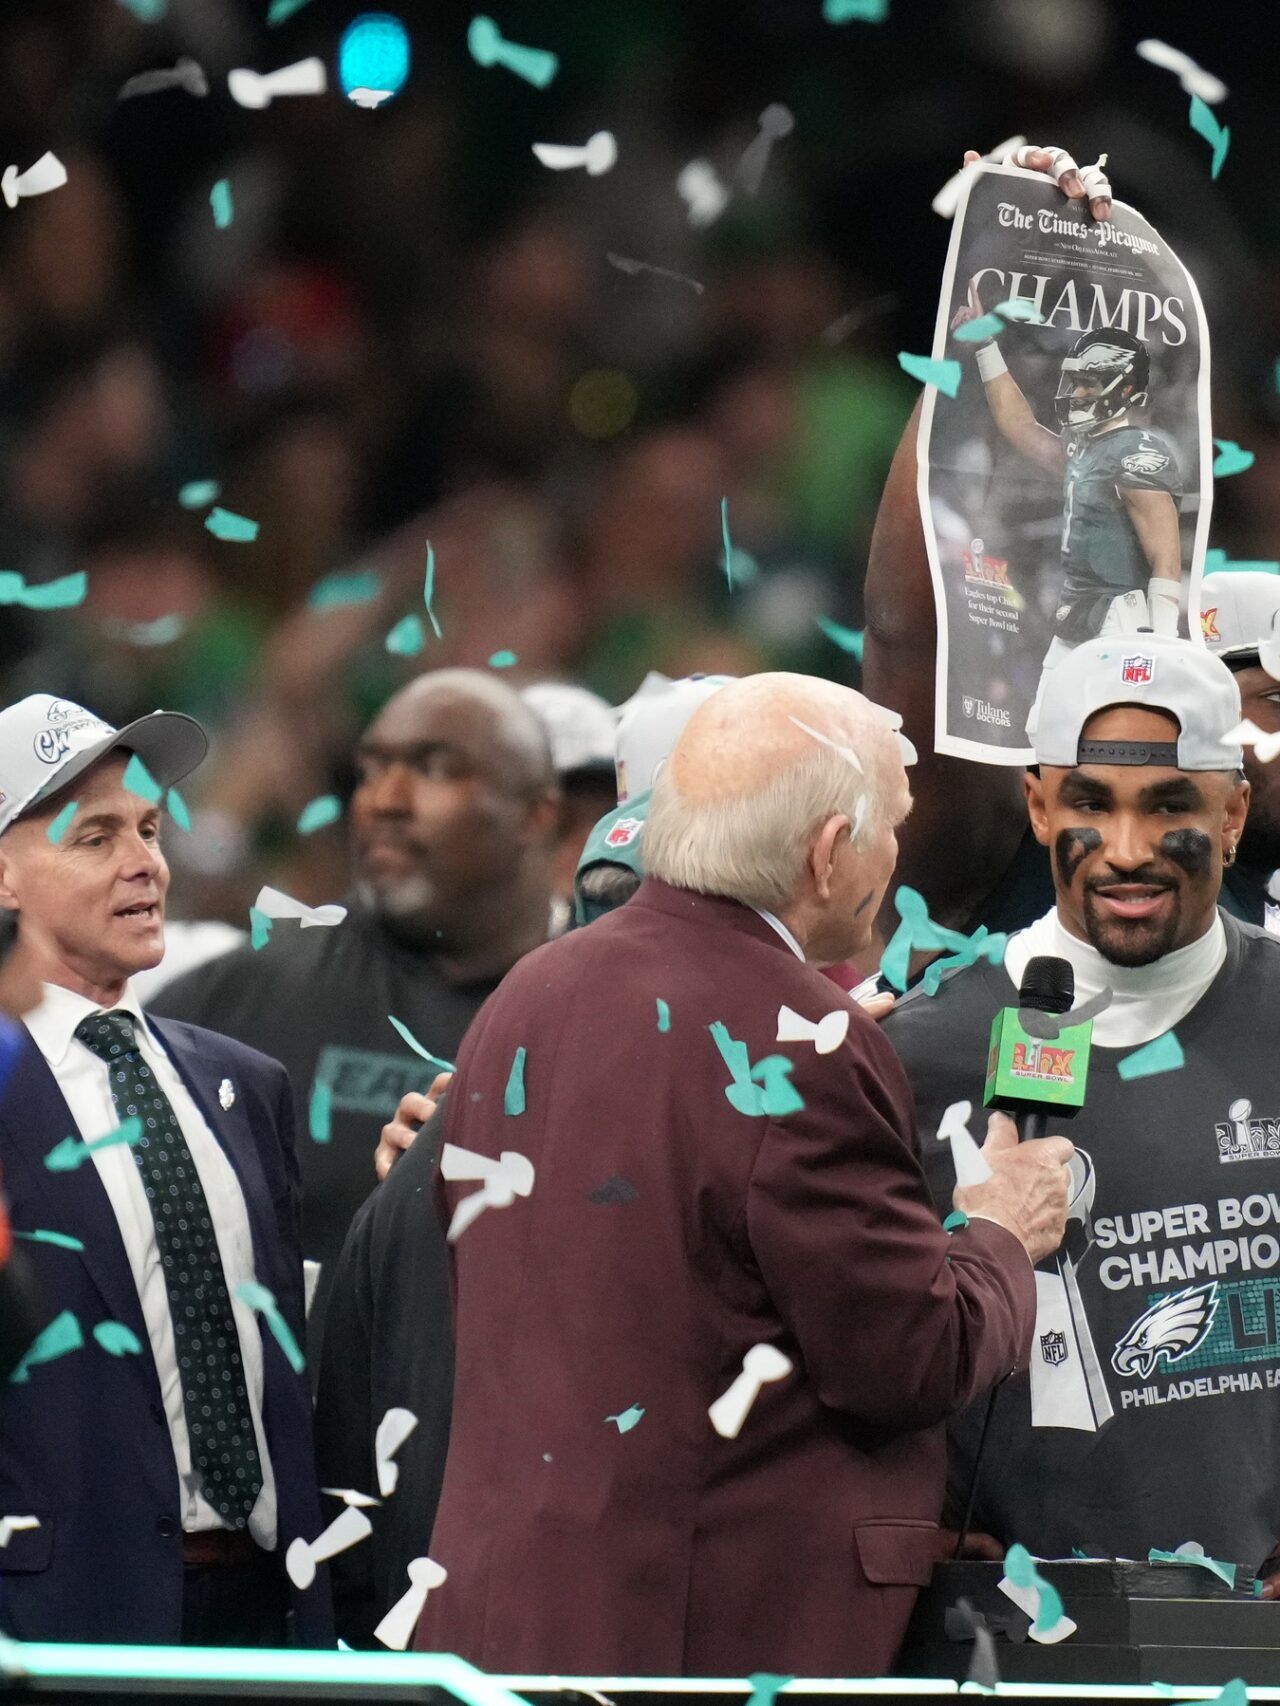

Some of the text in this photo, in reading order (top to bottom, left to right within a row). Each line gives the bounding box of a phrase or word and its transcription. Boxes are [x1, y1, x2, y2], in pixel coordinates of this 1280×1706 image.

[997, 202, 1033, 230] The
[968, 268, 1187, 347] CHAMPS
[968, 600, 1019, 620] for their second
[968, 612, 1020, 633] Super Bowl title
[1123, 667, 1151, 683] NFL
[975, 699, 1010, 720] Tulane
[976, 712, 1011, 727] DOCTORS
[1015, 1070, 1071, 1083] SUPER BOWL
[1229, 1152, 1260, 1161] SUPER
[1094, 1203, 1211, 1249] SUPER
[1043, 1344, 1065, 1362] NFL
[1120, 1372, 1263, 1409] PHILADELPHIA
